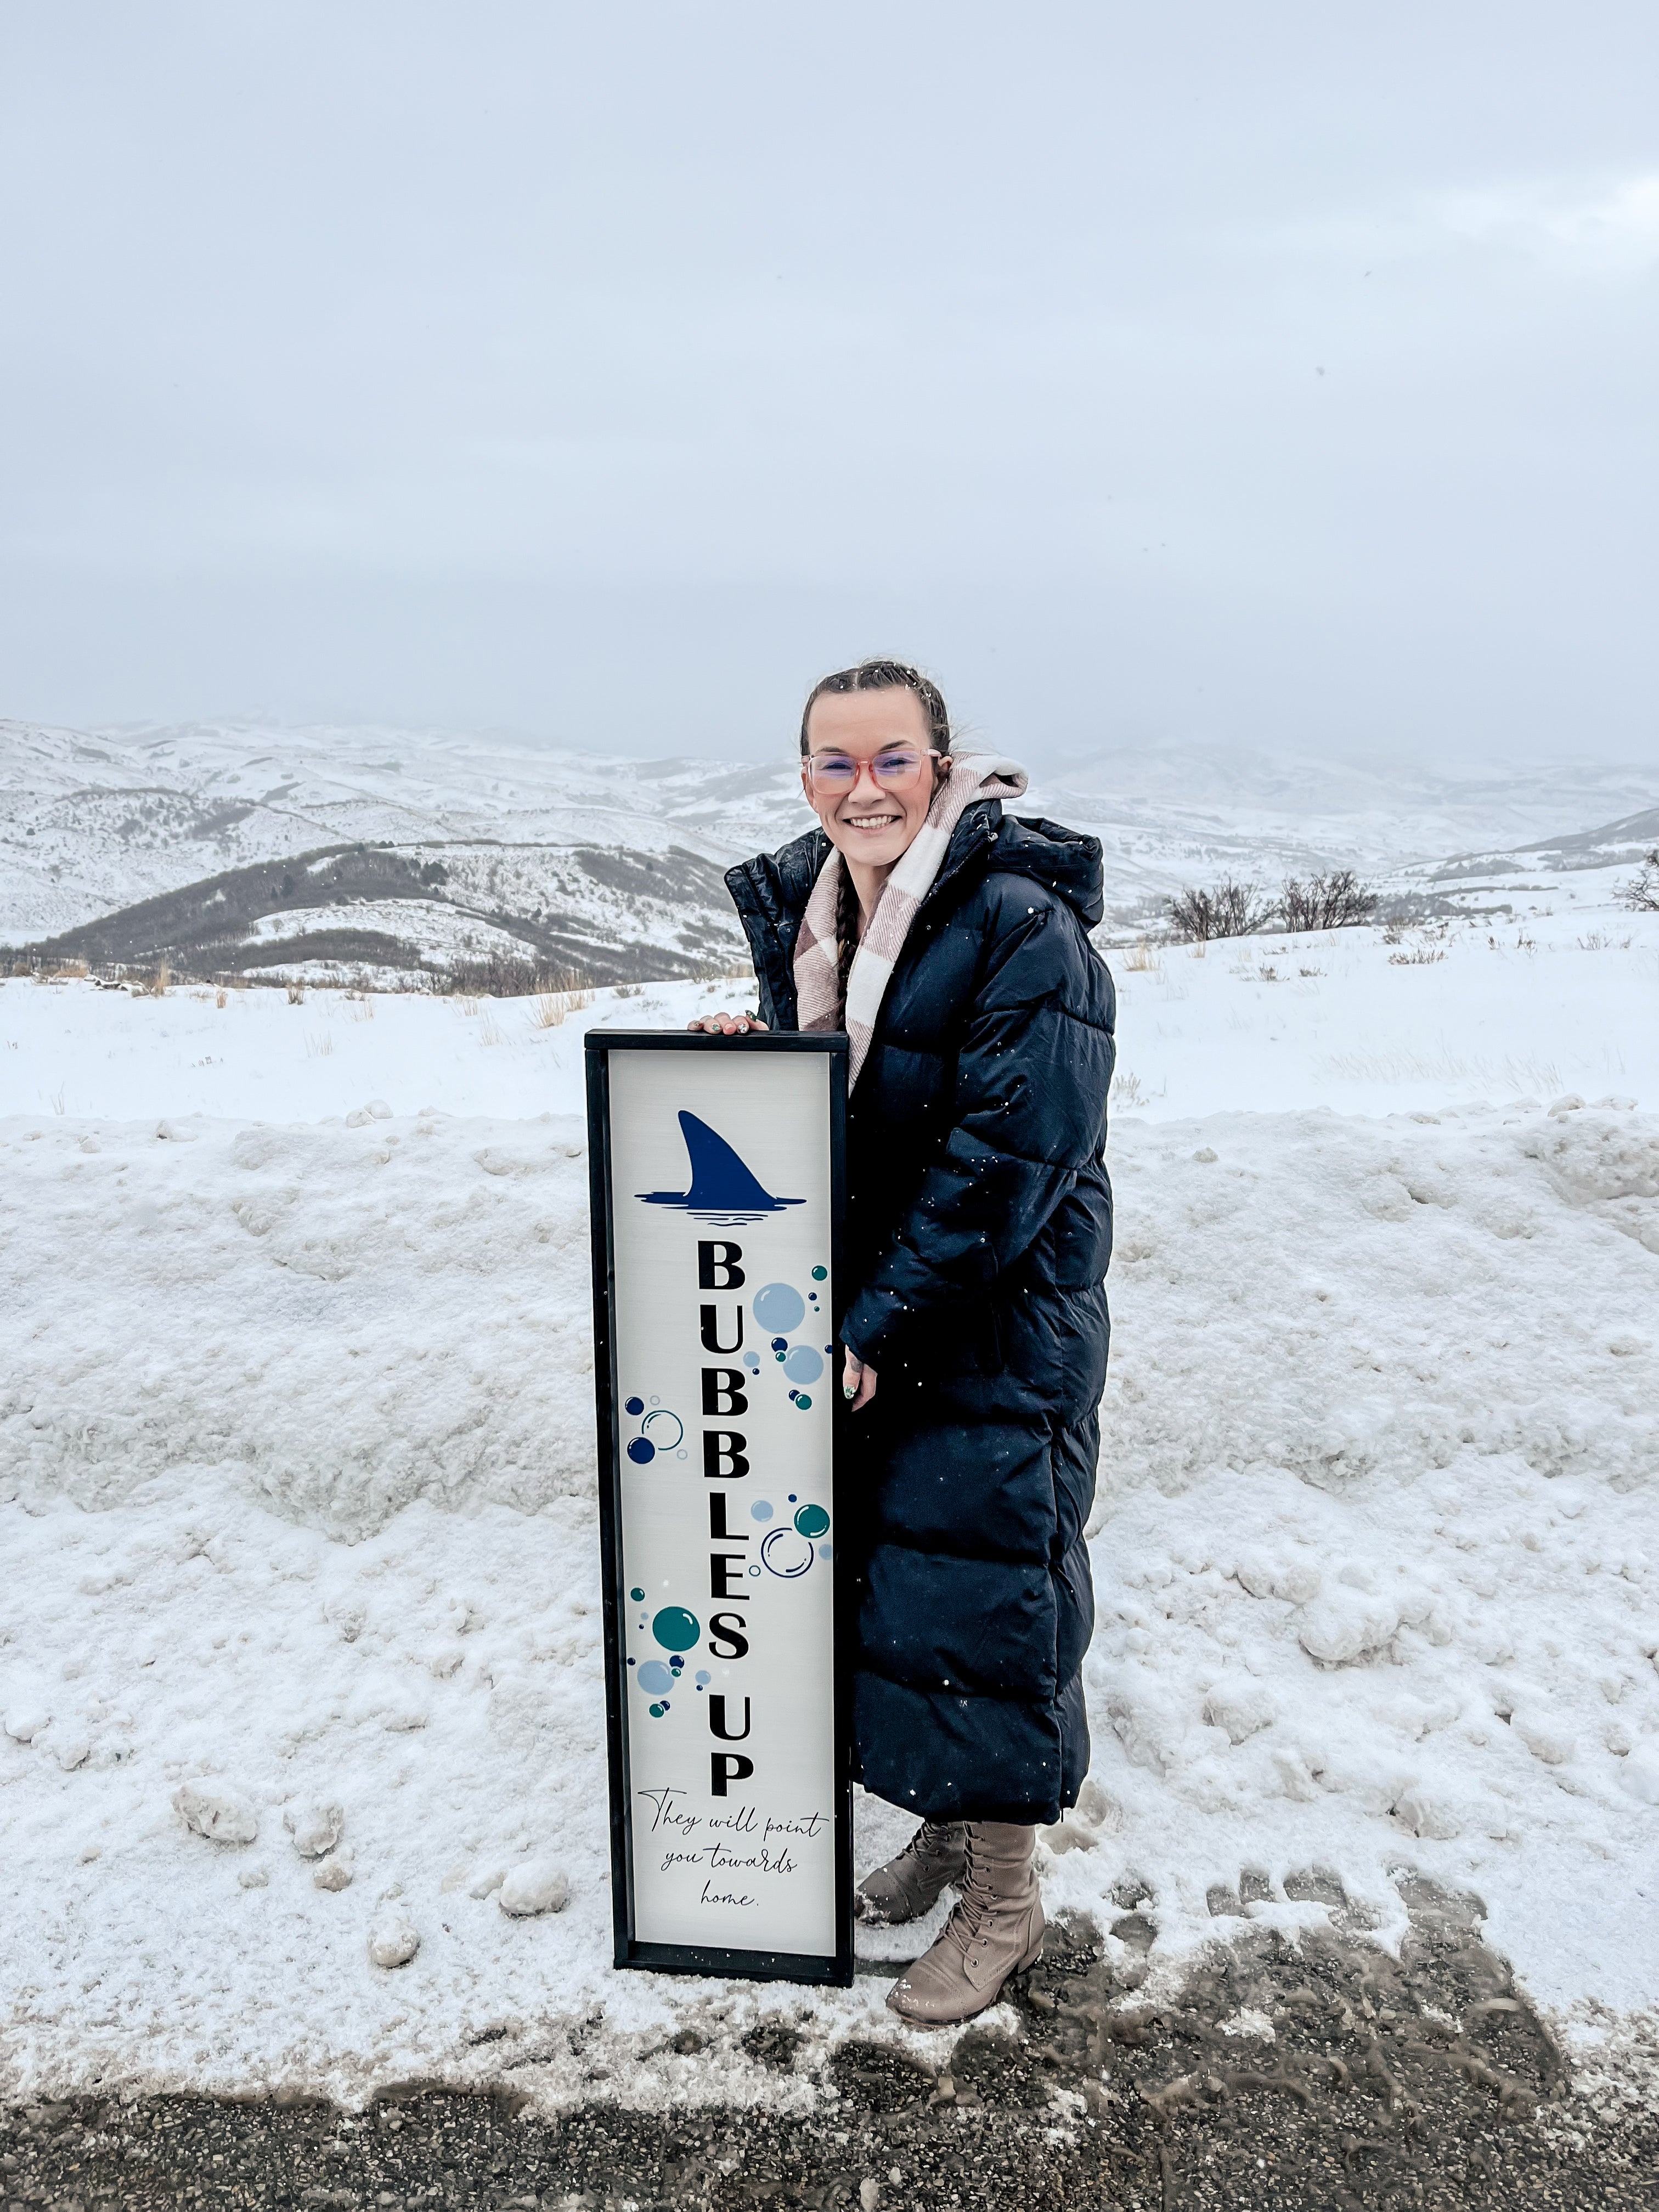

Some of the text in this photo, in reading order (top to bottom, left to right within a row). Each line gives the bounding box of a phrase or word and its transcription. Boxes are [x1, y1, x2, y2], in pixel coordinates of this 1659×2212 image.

[697, 1240, 754, 1797] BUBBLES UP
[637, 1787, 830, 1842] They will point
[661, 1842, 798, 1874] you towards
[700, 1879, 759, 1906] home.
